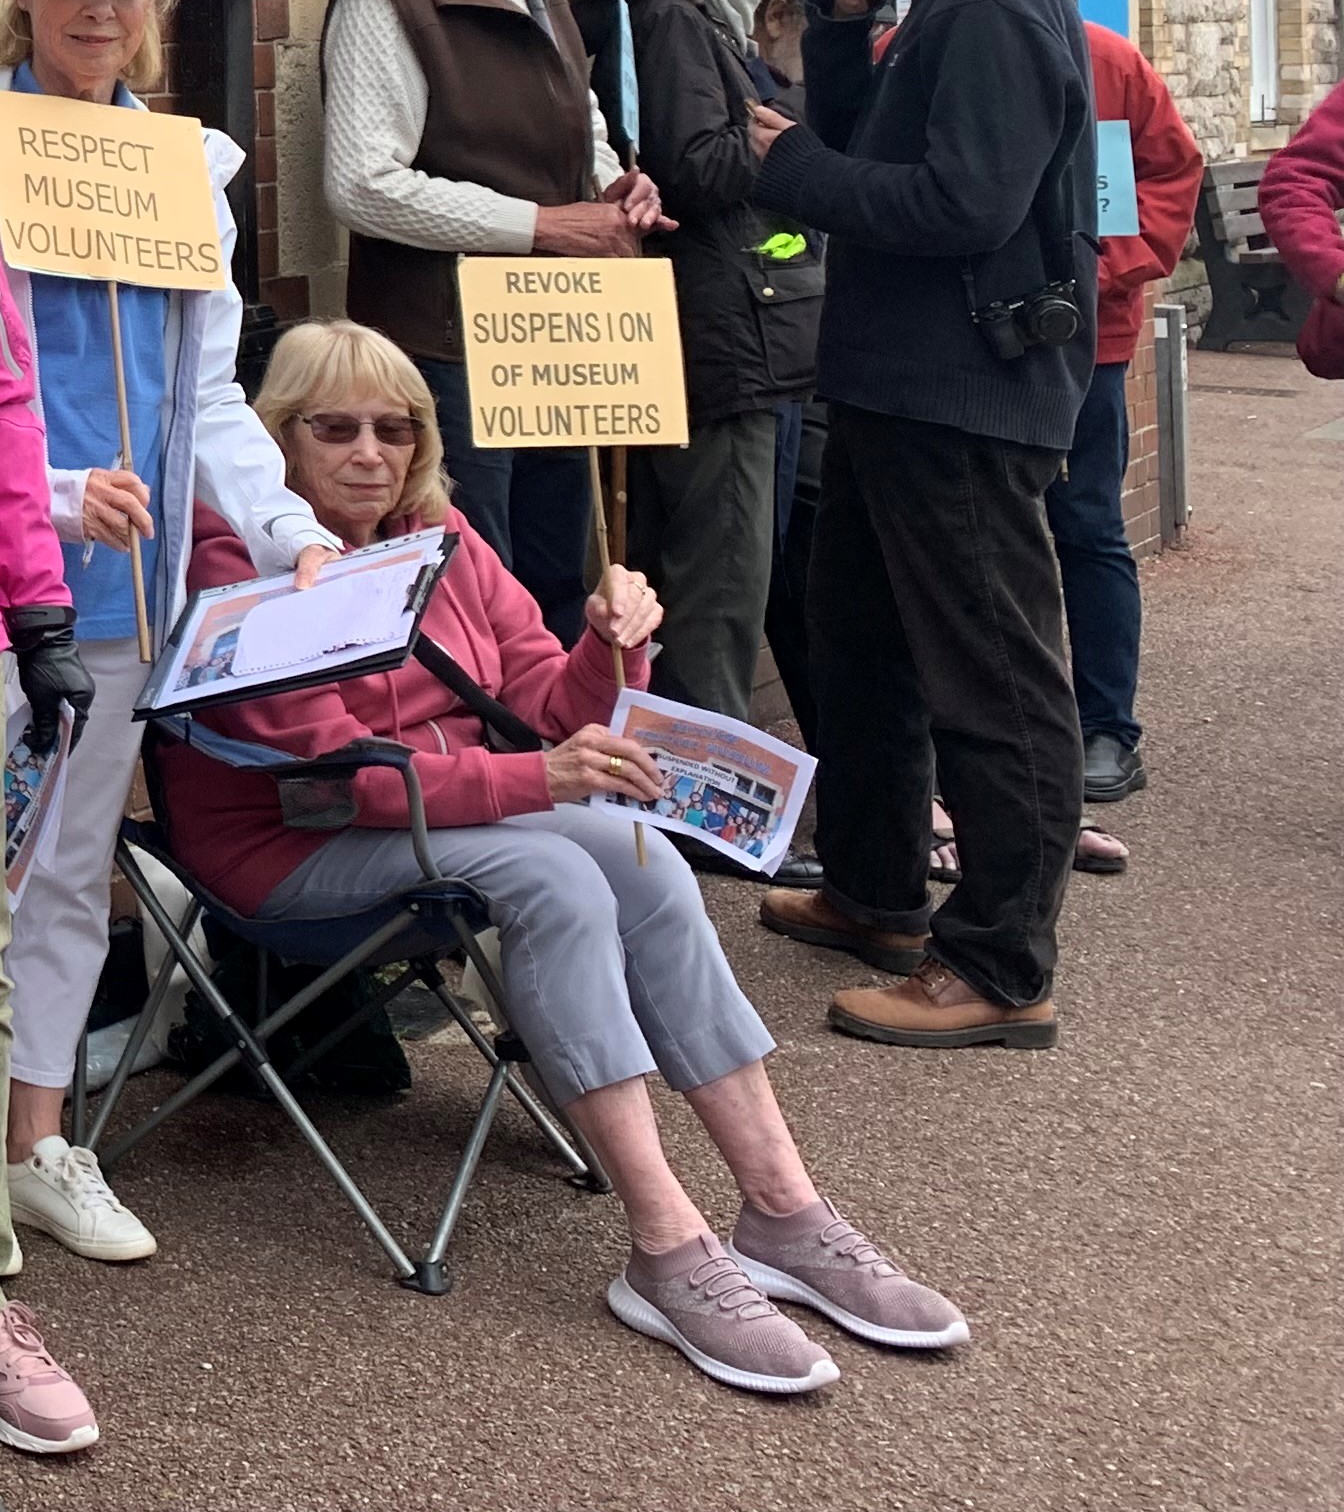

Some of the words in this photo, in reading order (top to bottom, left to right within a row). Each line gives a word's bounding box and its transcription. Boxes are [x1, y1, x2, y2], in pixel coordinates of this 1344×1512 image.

[18, 127, 154, 174] RESPECT
[24, 173, 159, 222] MUSEUM
[5, 218, 219, 274] VOLUNTEERS
[505, 272, 602, 294] REVOKE
[473, 312, 654, 343] SUSPENSION
[491, 364, 523, 386] OF
[532, 363, 639, 386] MUSEUM
[479, 403, 661, 438] VOLUNTEERS
[657, 753, 700, 770] SUSPENDED
[701, 765, 736, 784] WITHOUT
[671, 765, 721, 787] EXPLANATION
